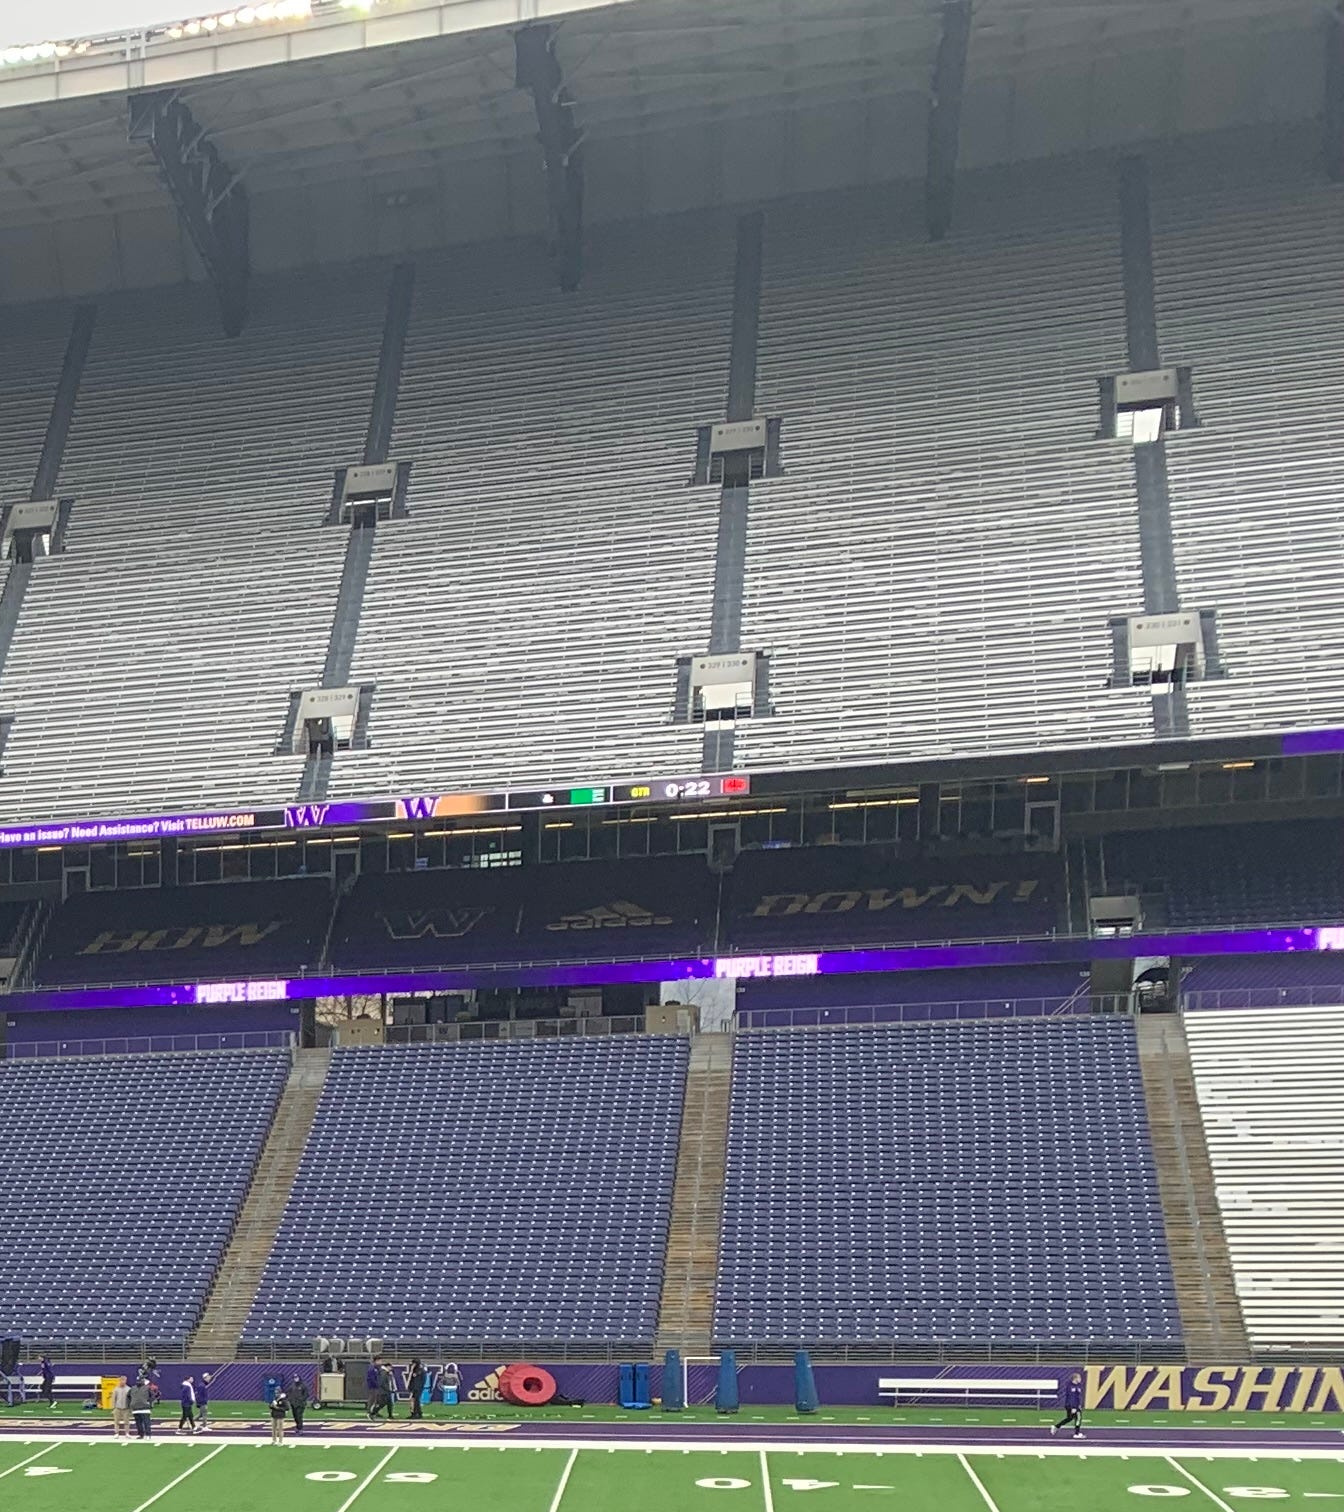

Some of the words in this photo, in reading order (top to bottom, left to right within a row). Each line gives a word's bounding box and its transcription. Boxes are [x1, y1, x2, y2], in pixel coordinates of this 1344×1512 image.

[665, 780, 711, 798] 0:22
[397, 796, 441, 819] W
[71, 826, 98, 838] Need
[99, 821, 160, 836] Assistance?
[161, 818, 185, 831] Visit
[185, 813, 255, 829] TELLUW.COM
[75, 921, 282, 955] BOW
[737, 880, 1040, 918] DOWN!
[716, 957, 771, 978] PURPLE
[773, 954, 818, 976] REIGN
[196, 984, 245, 1003] PURPLE
[246, 981, 287, 1000] REIGN
[1083, 1365, 1344, 1412] WASHIN
